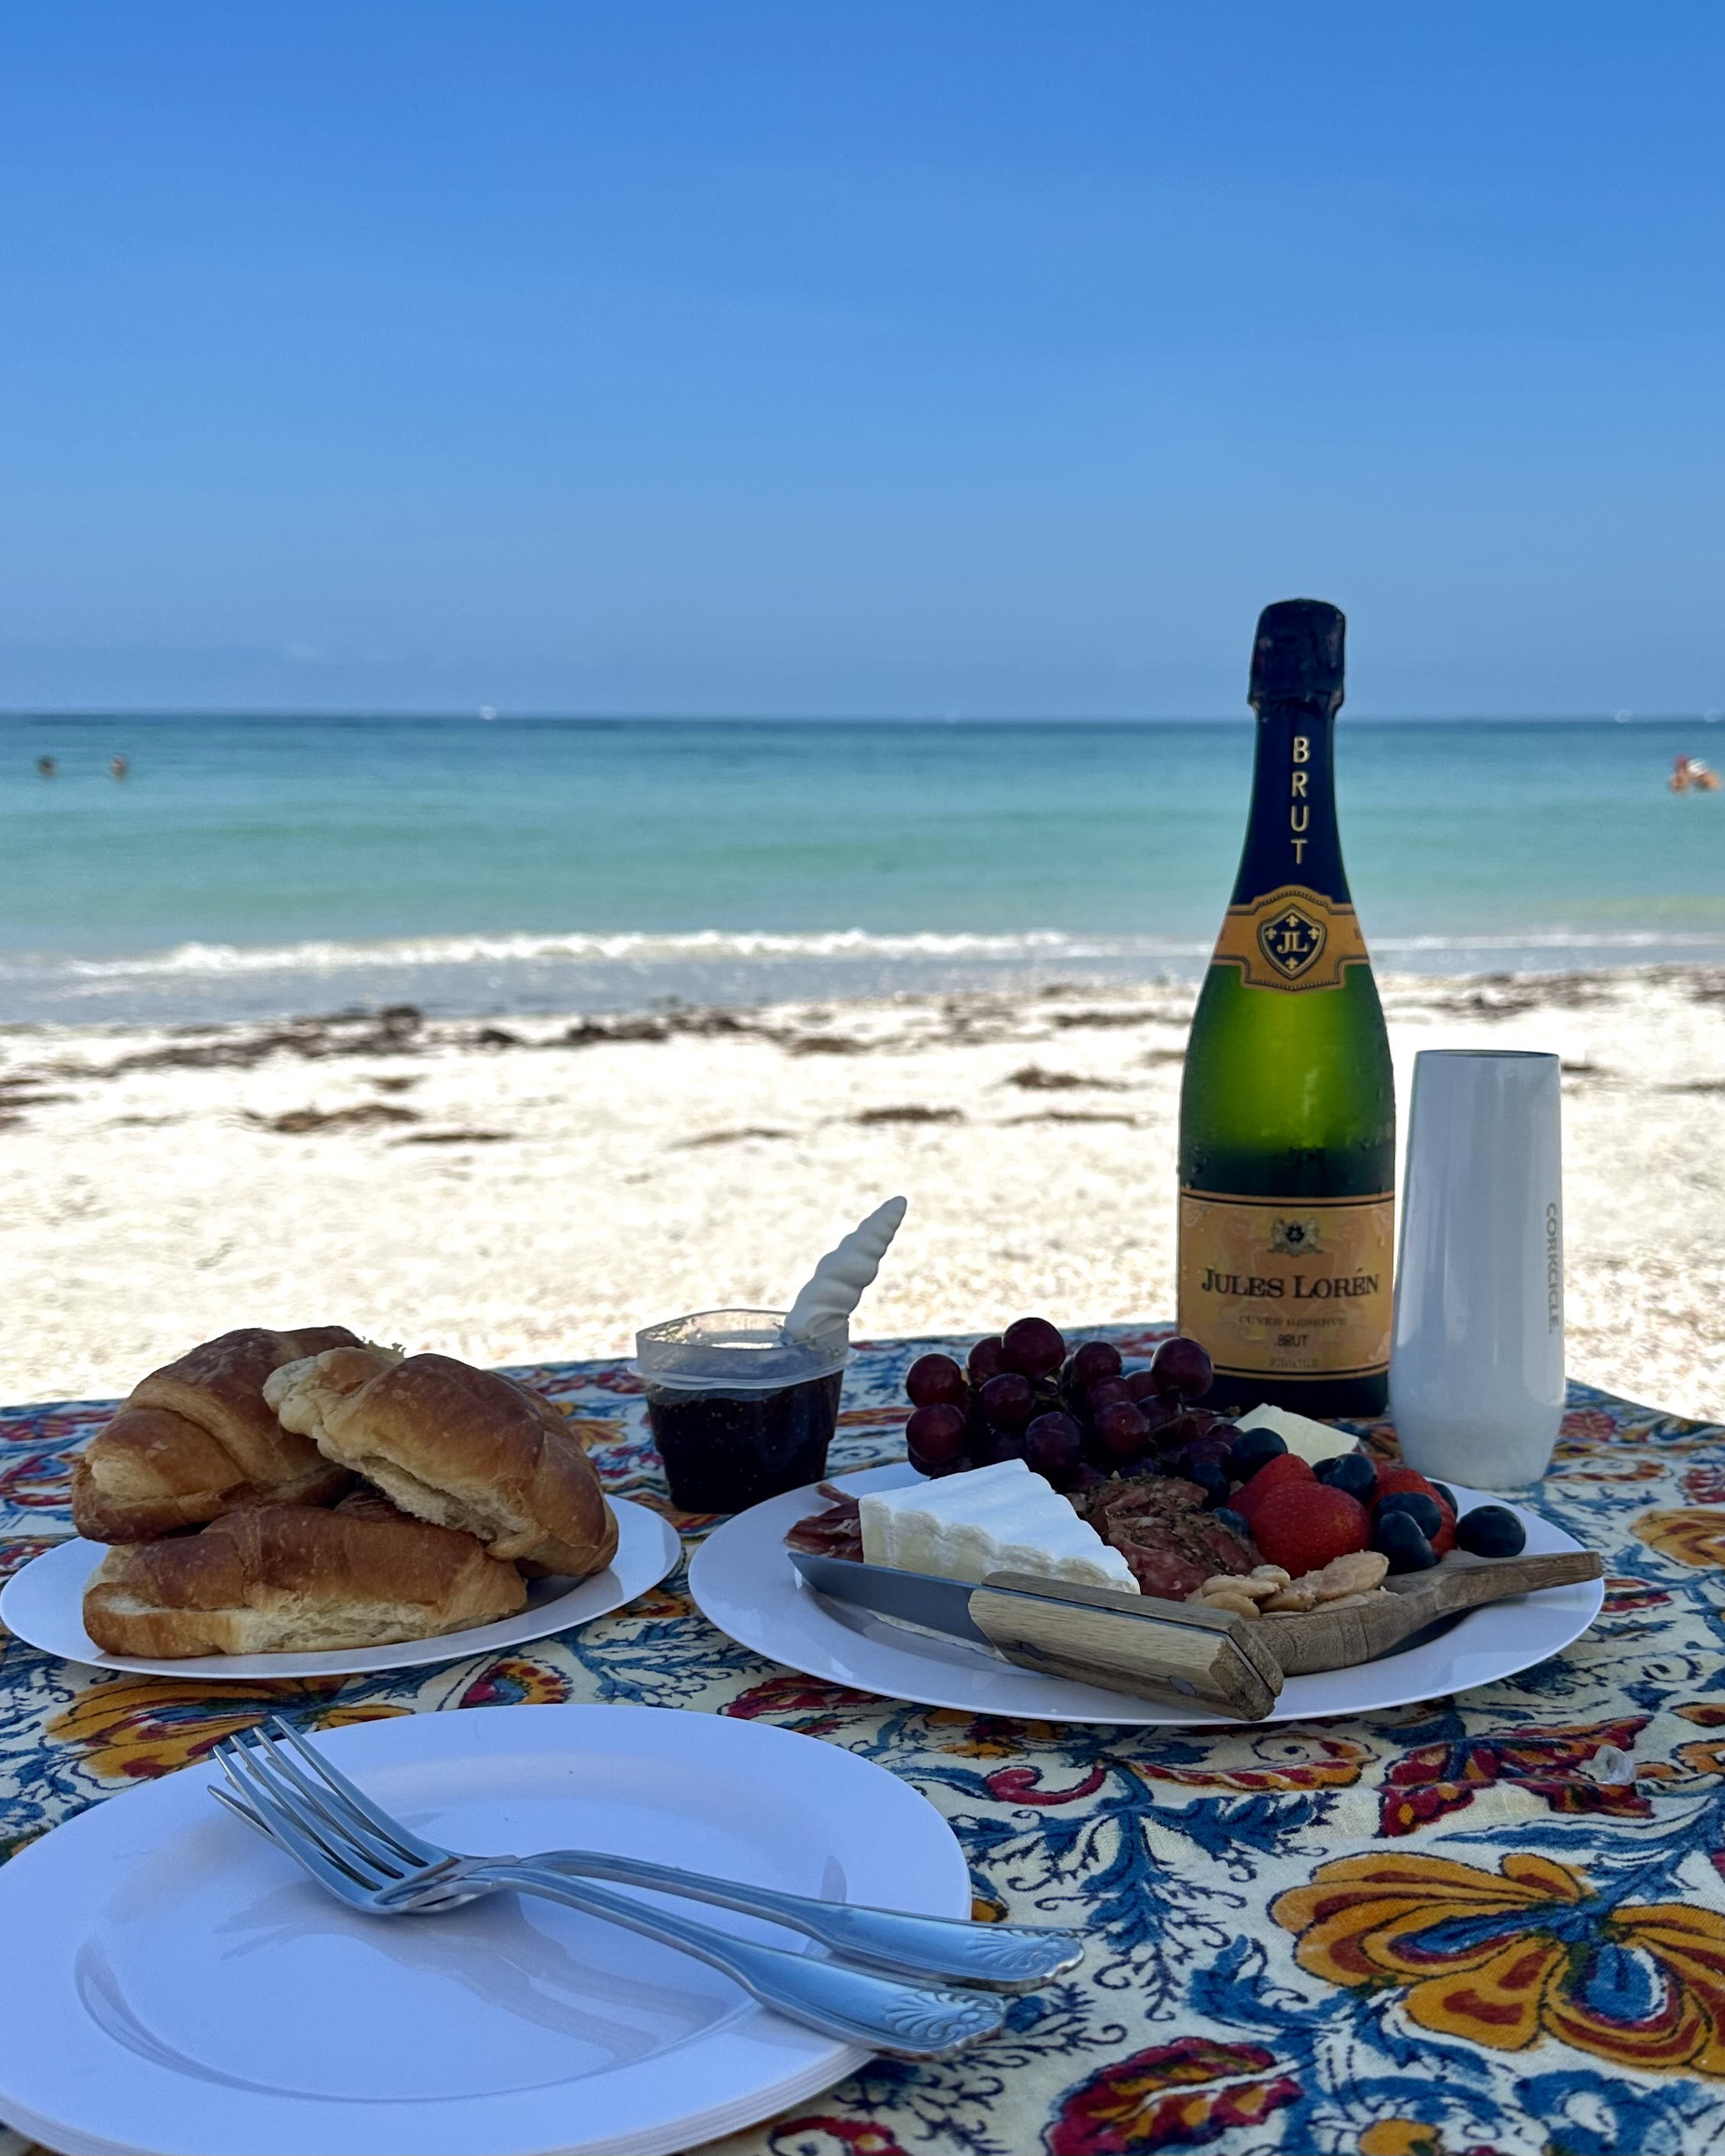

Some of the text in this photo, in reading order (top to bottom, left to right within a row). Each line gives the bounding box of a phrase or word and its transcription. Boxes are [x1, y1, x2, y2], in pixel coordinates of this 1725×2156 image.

[1291, 735, 1310, 864] BRUT
[1276, 930, 1309, 954] JL
[1278, 1334, 1309, 1347] BRUT
